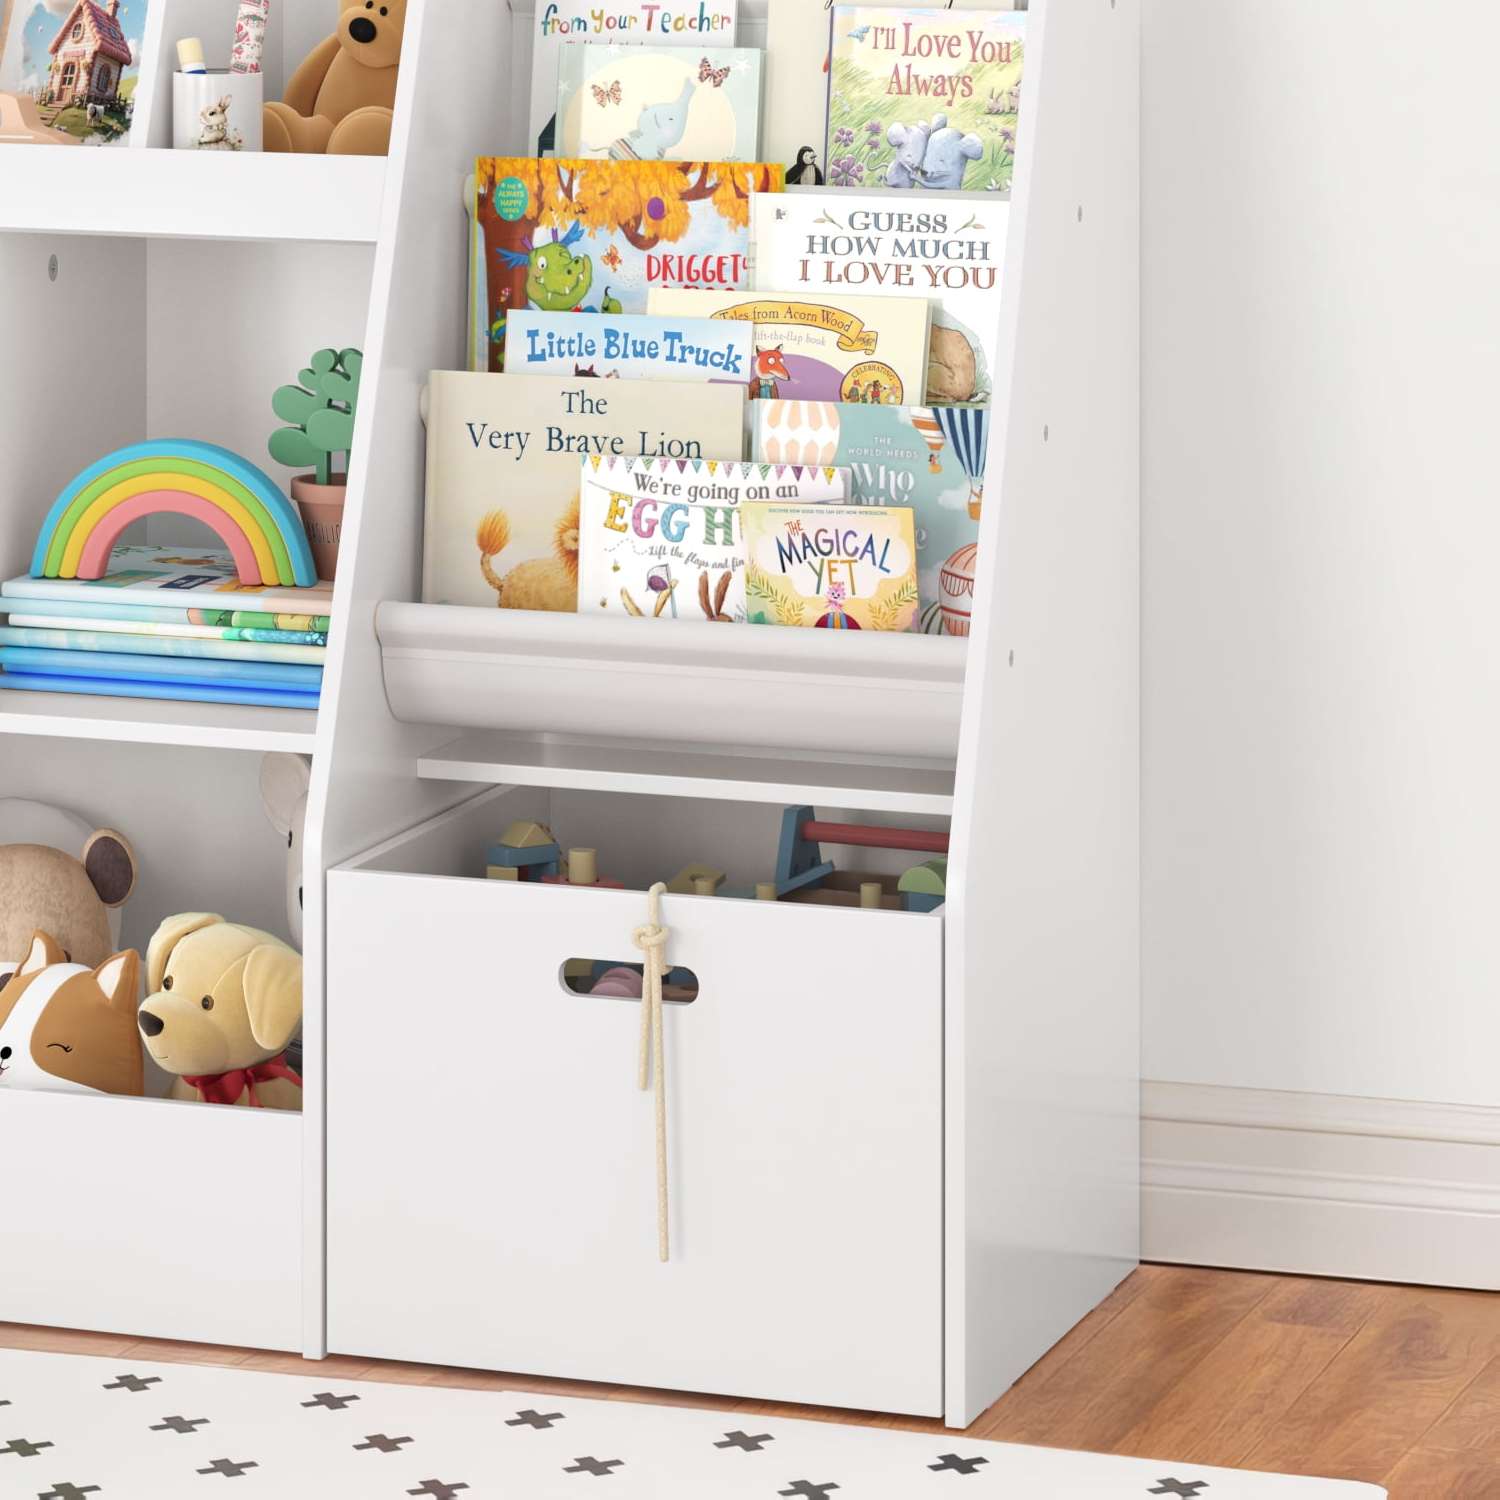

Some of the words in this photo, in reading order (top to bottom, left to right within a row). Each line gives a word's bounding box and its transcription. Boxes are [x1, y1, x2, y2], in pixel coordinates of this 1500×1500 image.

[541, 3, 587, 37] from
[641, 1, 732, 34] Teacher
[872, 26, 897, 50] I'll
[901, 22, 961, 59] Love
[965, 30, 1013, 64] You
[886, 63, 974, 107] Always
[848, 210, 948, 234] GUESS
[805, 235, 883, 257] HOW
[892, 238, 991, 261] MUCH
[799, 259, 811, 282] I
[822, 260, 915, 287] LOVE
[921, 264, 998, 290] YOU
[753, 307, 780, 321] from
[783, 305, 818, 323] Acorn
[821, 310, 854, 332] Wood
[526, 329, 596, 362] Little
[604, 328, 659, 359] Blue
[663, 331, 742, 374] Truck
[806, 334, 827, 347] book
[851, 364, 895, 381] CELEBRATING
[561, 390, 608, 415] The
[466, 422, 531, 460] Very
[545, 427, 624, 455] Brave
[638, 431, 703, 460] Lion
[848, 447, 882, 457] WORLD
[886, 449, 919, 460] NEEDS
[873, 436, 893, 445] THE
[633, 472, 682, 496] We're
[687, 483, 740, 505] going
[746, 486, 770, 500] on
[776, 484, 799, 498] an
[850, 461, 915, 503] Who
[603, 491, 690, 543] EGG
[784, 519, 804, 537] THE
[648, 545, 668, 559] Lift
[670, 546, 684, 559] the
[684, 552, 710, 570] flaps
[711, 559, 729, 570] and
[775, 528, 892, 574] MAGICAL
[808, 558, 858, 596] YET
